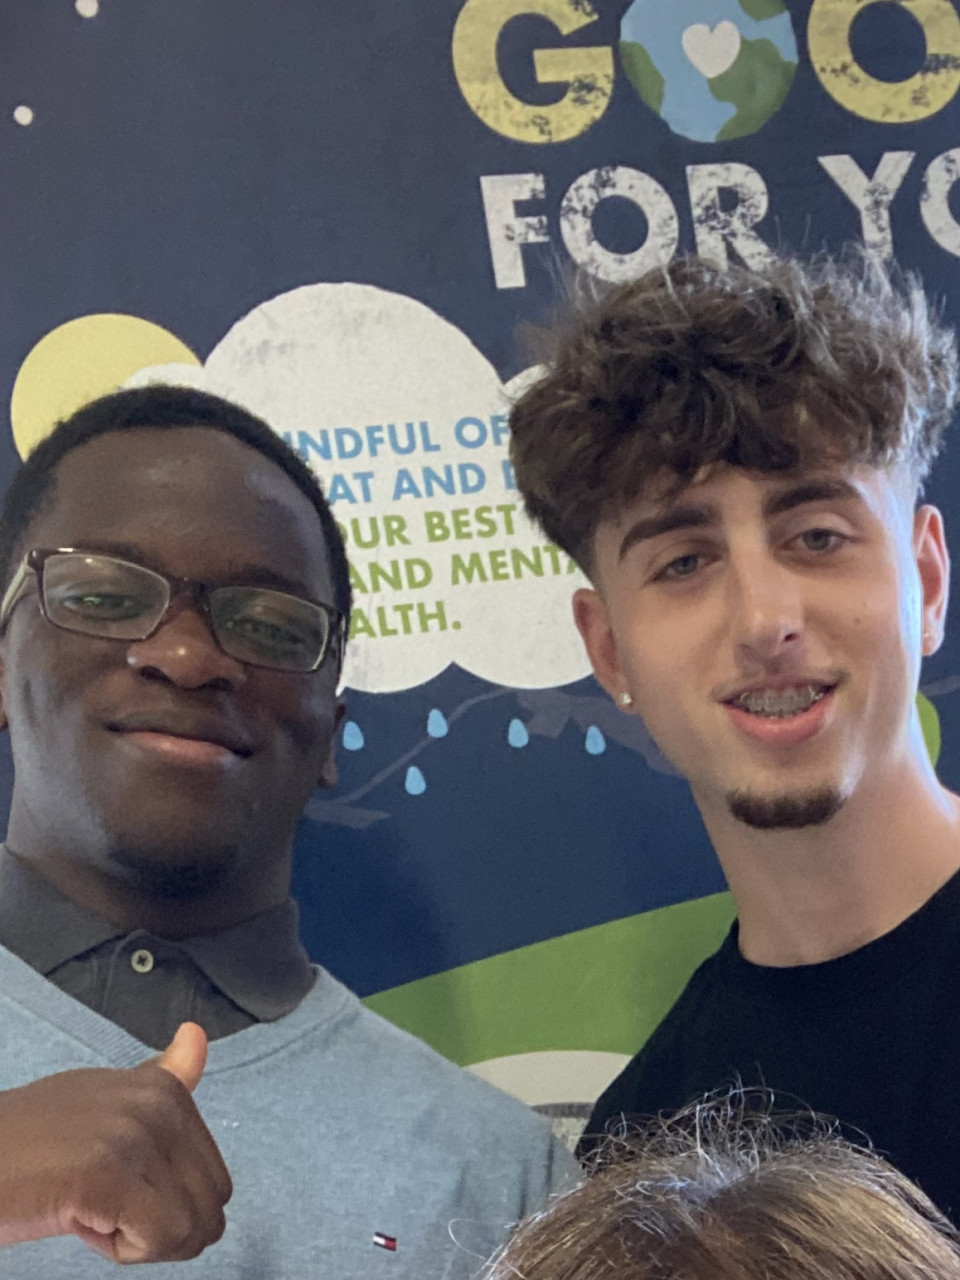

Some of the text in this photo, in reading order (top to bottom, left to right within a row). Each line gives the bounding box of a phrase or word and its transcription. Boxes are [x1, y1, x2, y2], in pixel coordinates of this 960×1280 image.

[480, 162, 776, 289] FOR
[454, 414, 510, 449] OF
[327, 471, 375, 506] AT
[392, 462, 487, 501] AND
[339, 504, 517, 550] UR BEST
[349, 558, 433, 594] AND
[348, 600, 463, 640] ALTH.
